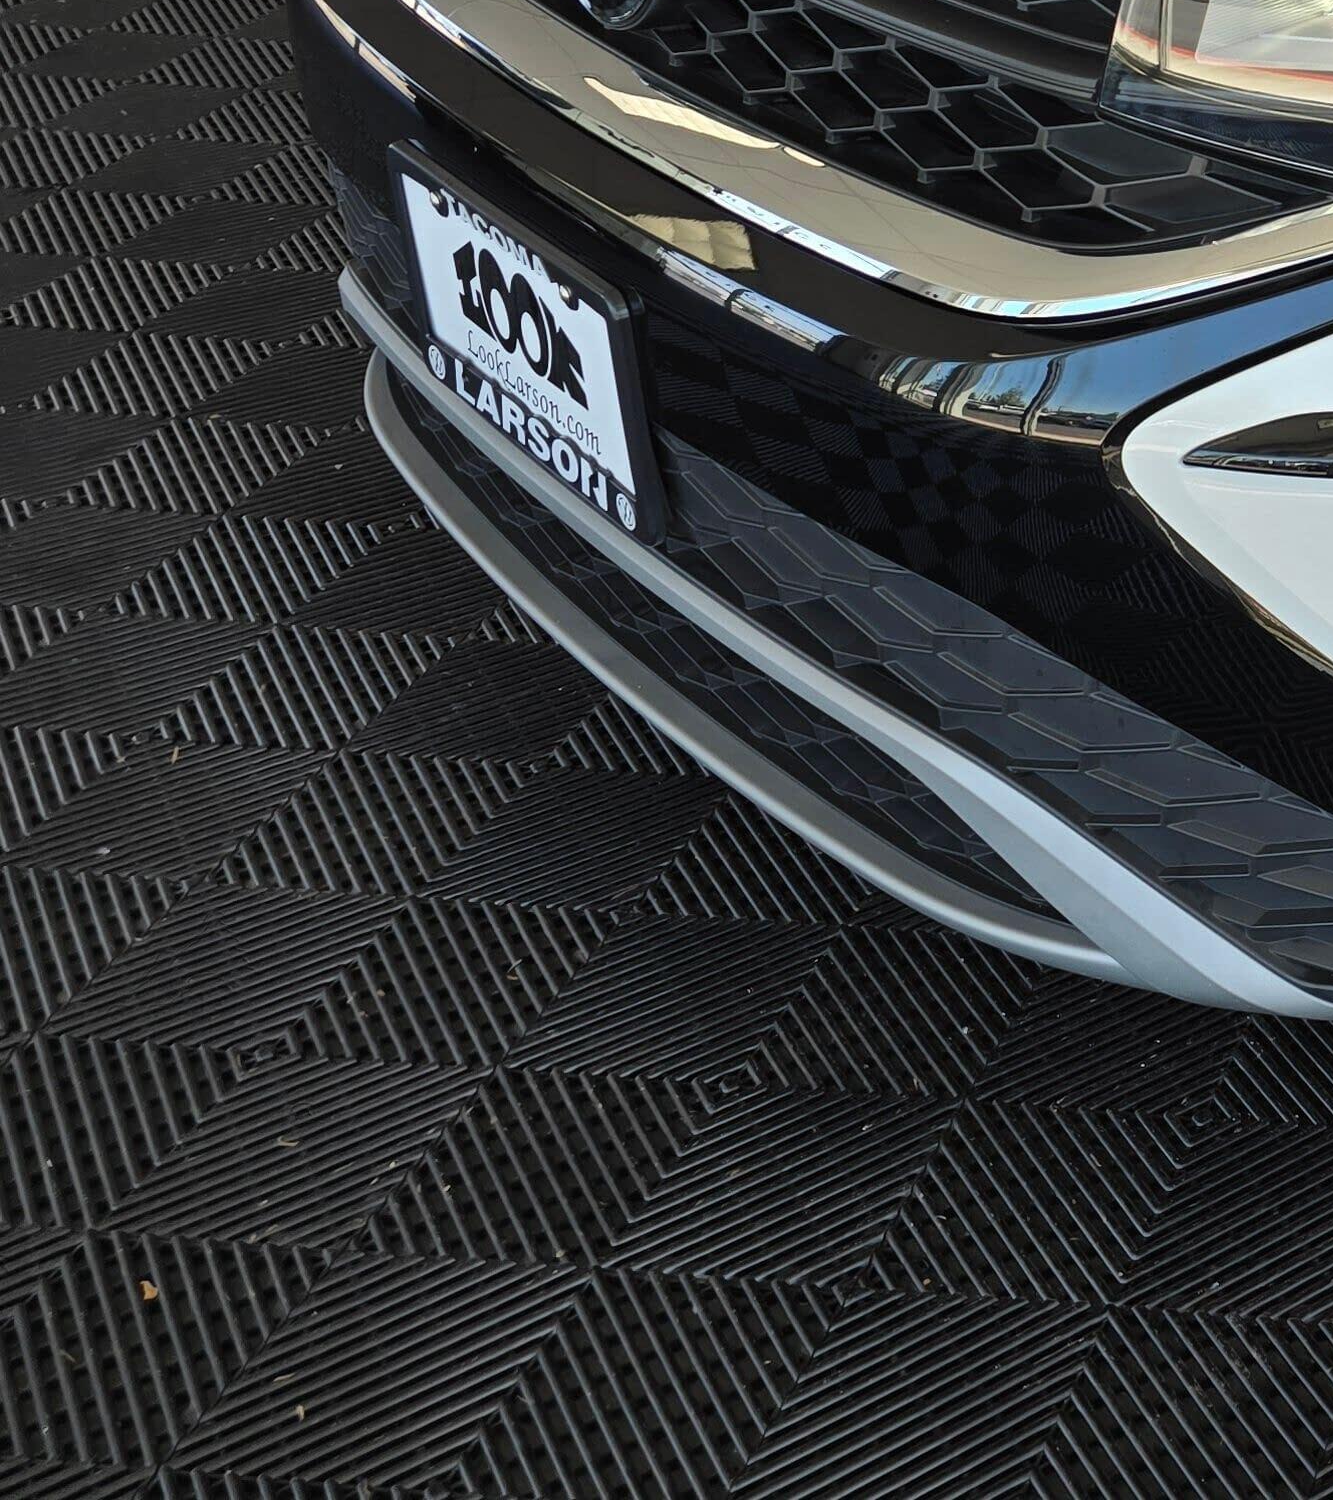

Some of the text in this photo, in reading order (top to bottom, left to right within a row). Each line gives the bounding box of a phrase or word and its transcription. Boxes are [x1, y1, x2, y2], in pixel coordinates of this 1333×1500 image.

[440, 188, 551, 278] TACOMA
[453, 241, 588, 410] LOOK
[467, 330, 601, 455] LookLarson.com
[454, 358, 608, 511] LARSON
